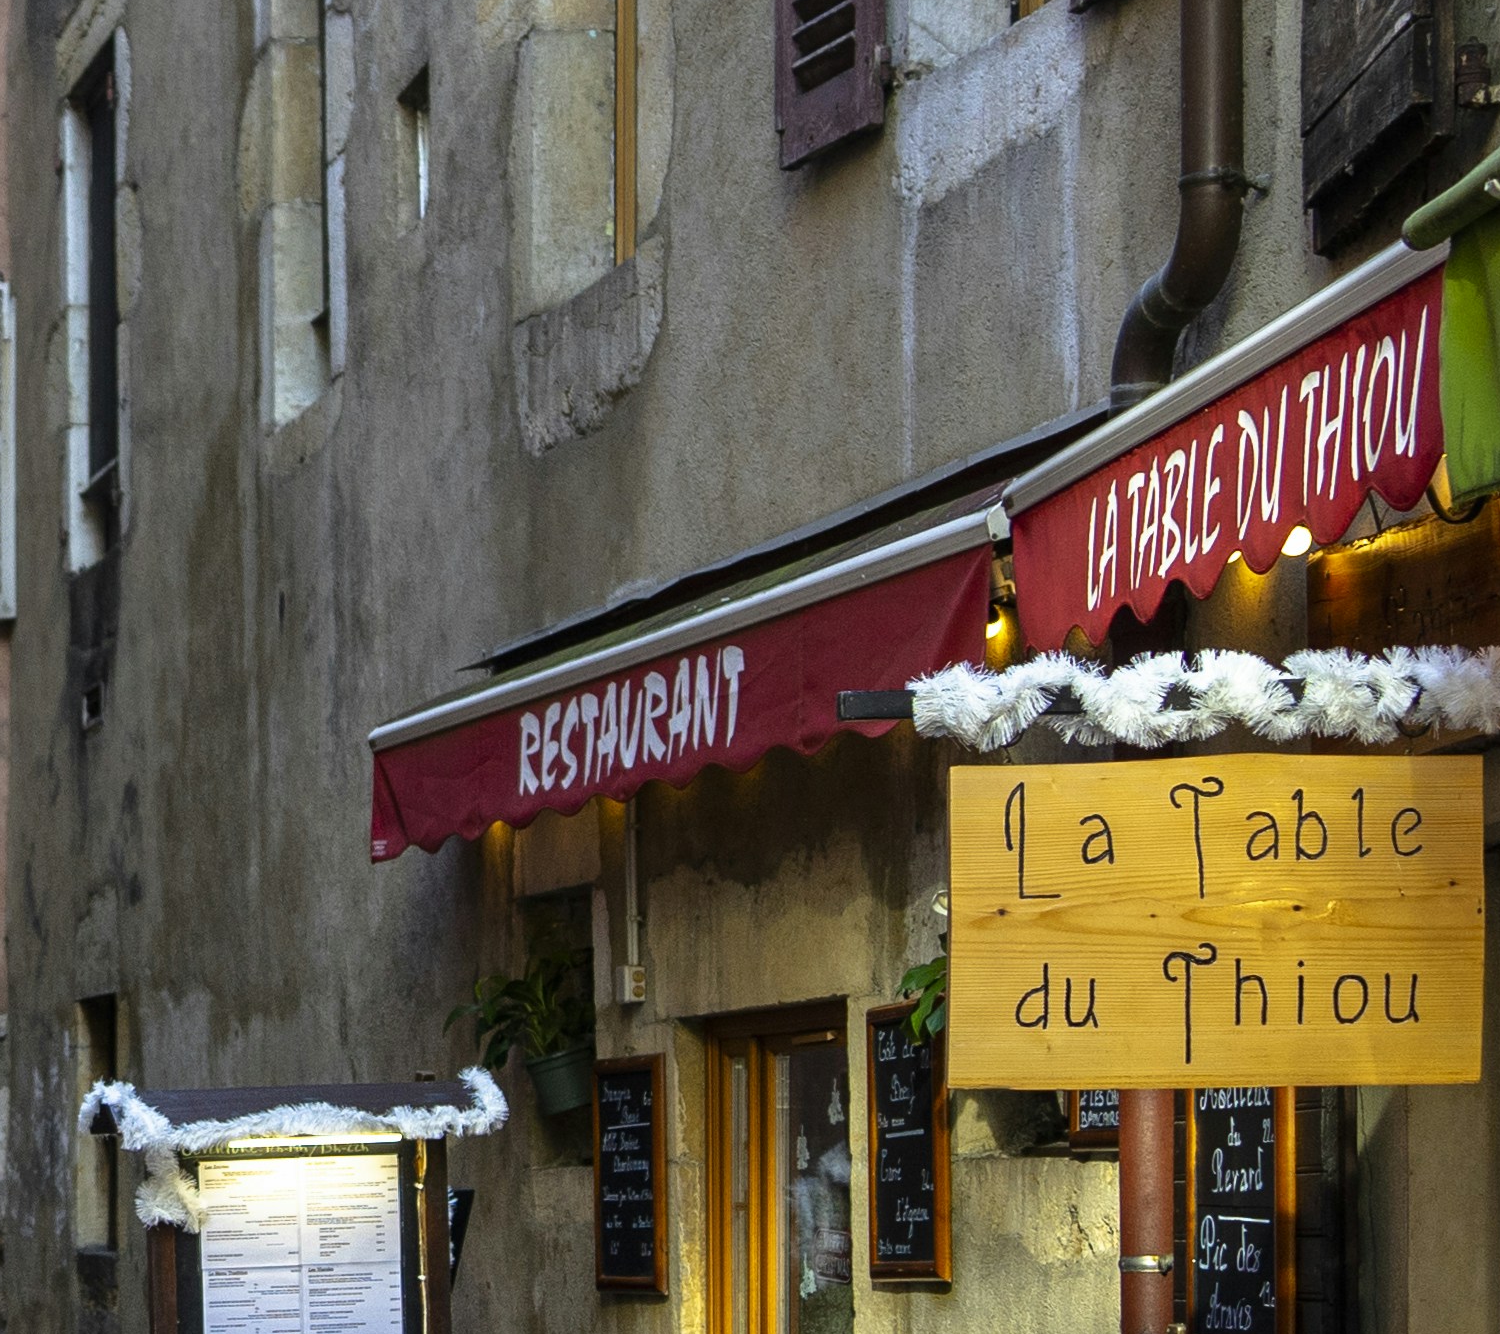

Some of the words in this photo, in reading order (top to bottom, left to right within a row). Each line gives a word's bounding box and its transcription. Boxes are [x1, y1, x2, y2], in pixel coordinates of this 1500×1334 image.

[1087, 479, 1118, 612] LA
[1127, 423, 1224, 590] TABLE
[1236, 384, 1288, 541] DU
[1299, 304, 1428, 507] THIOU
[519, 645, 745, 797] RESTAURANT
[1004, 781, 1115, 900] La
[1169, 775, 1424, 900] Table
[1014, 962, 1100, 1030] du
[1162, 941, 1421, 1065] Thiou
[1211, 1146, 1264, 1193] Revard
[1227, 1116, 1242, 1147] du
[1199, 1215, 1229, 1271] Pic
[1236, 1223, 1261, 1273] des
